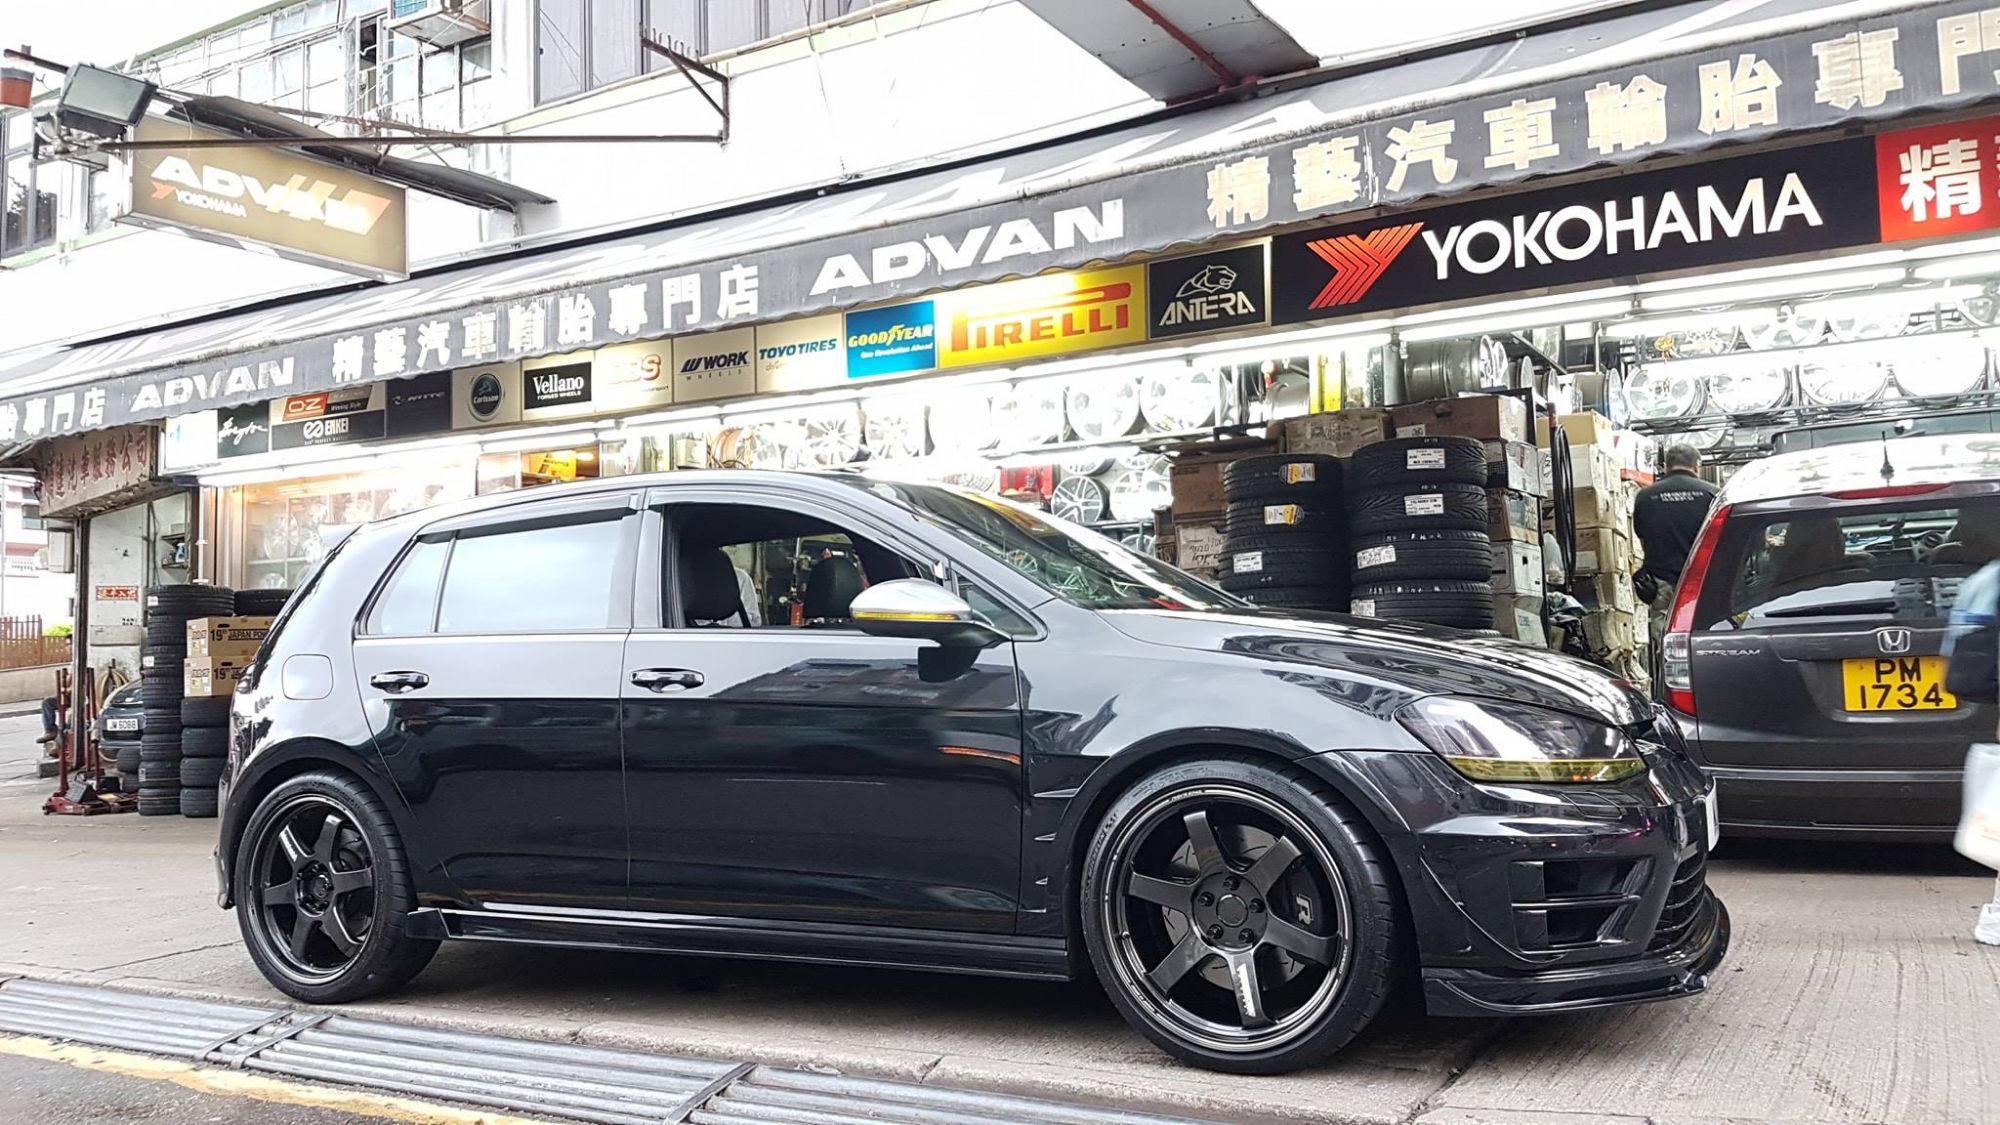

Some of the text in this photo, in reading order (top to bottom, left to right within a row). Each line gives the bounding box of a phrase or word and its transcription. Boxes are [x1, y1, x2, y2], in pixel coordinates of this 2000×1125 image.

[1898, 134, 2000, 222] 精
[175, 188, 247, 218] YOKOHAMA
[1422, 172, 1823, 280] YOKOHAMA
[809, 198, 1124, 296] ADVAN
[951, 281, 1132, 353] PIRELLI
[1159, 291, 1256, 327] ANTERA
[847, 324, 934, 348] GOODYEAR
[702, 351, 749, 371] WORK
[130, 356, 295, 413] ADVAN
[532, 373, 585, 395] Vellano
[288, 397, 322, 414] OZ
[325, 417, 349, 436] ENKEI
[1874, 657, 1922, 683] PM
[1860, 682, 1943, 709] 1734
